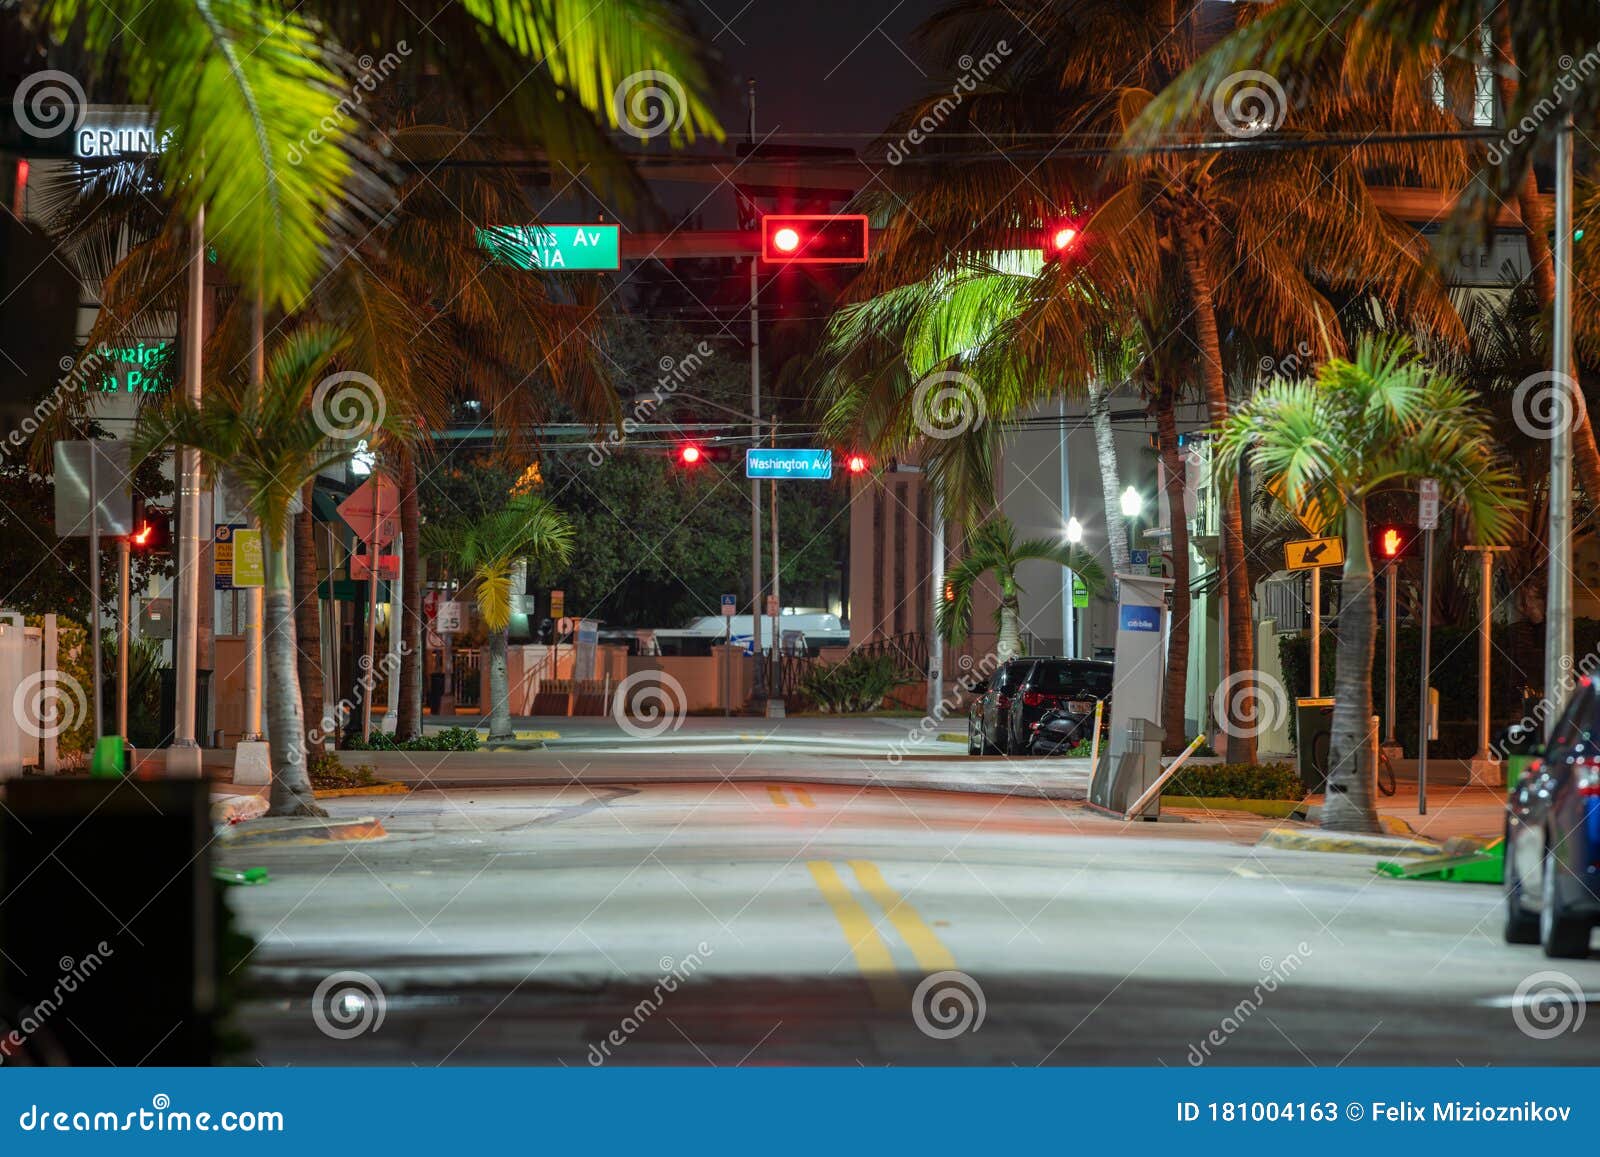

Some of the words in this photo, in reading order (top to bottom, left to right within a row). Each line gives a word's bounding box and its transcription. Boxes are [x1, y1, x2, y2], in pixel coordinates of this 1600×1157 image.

[573, 228, 600, 246] Av
[529, 249, 565, 267] A1A
[750, 458, 808, 472] Washington
[442, 617, 459, 629] 25
